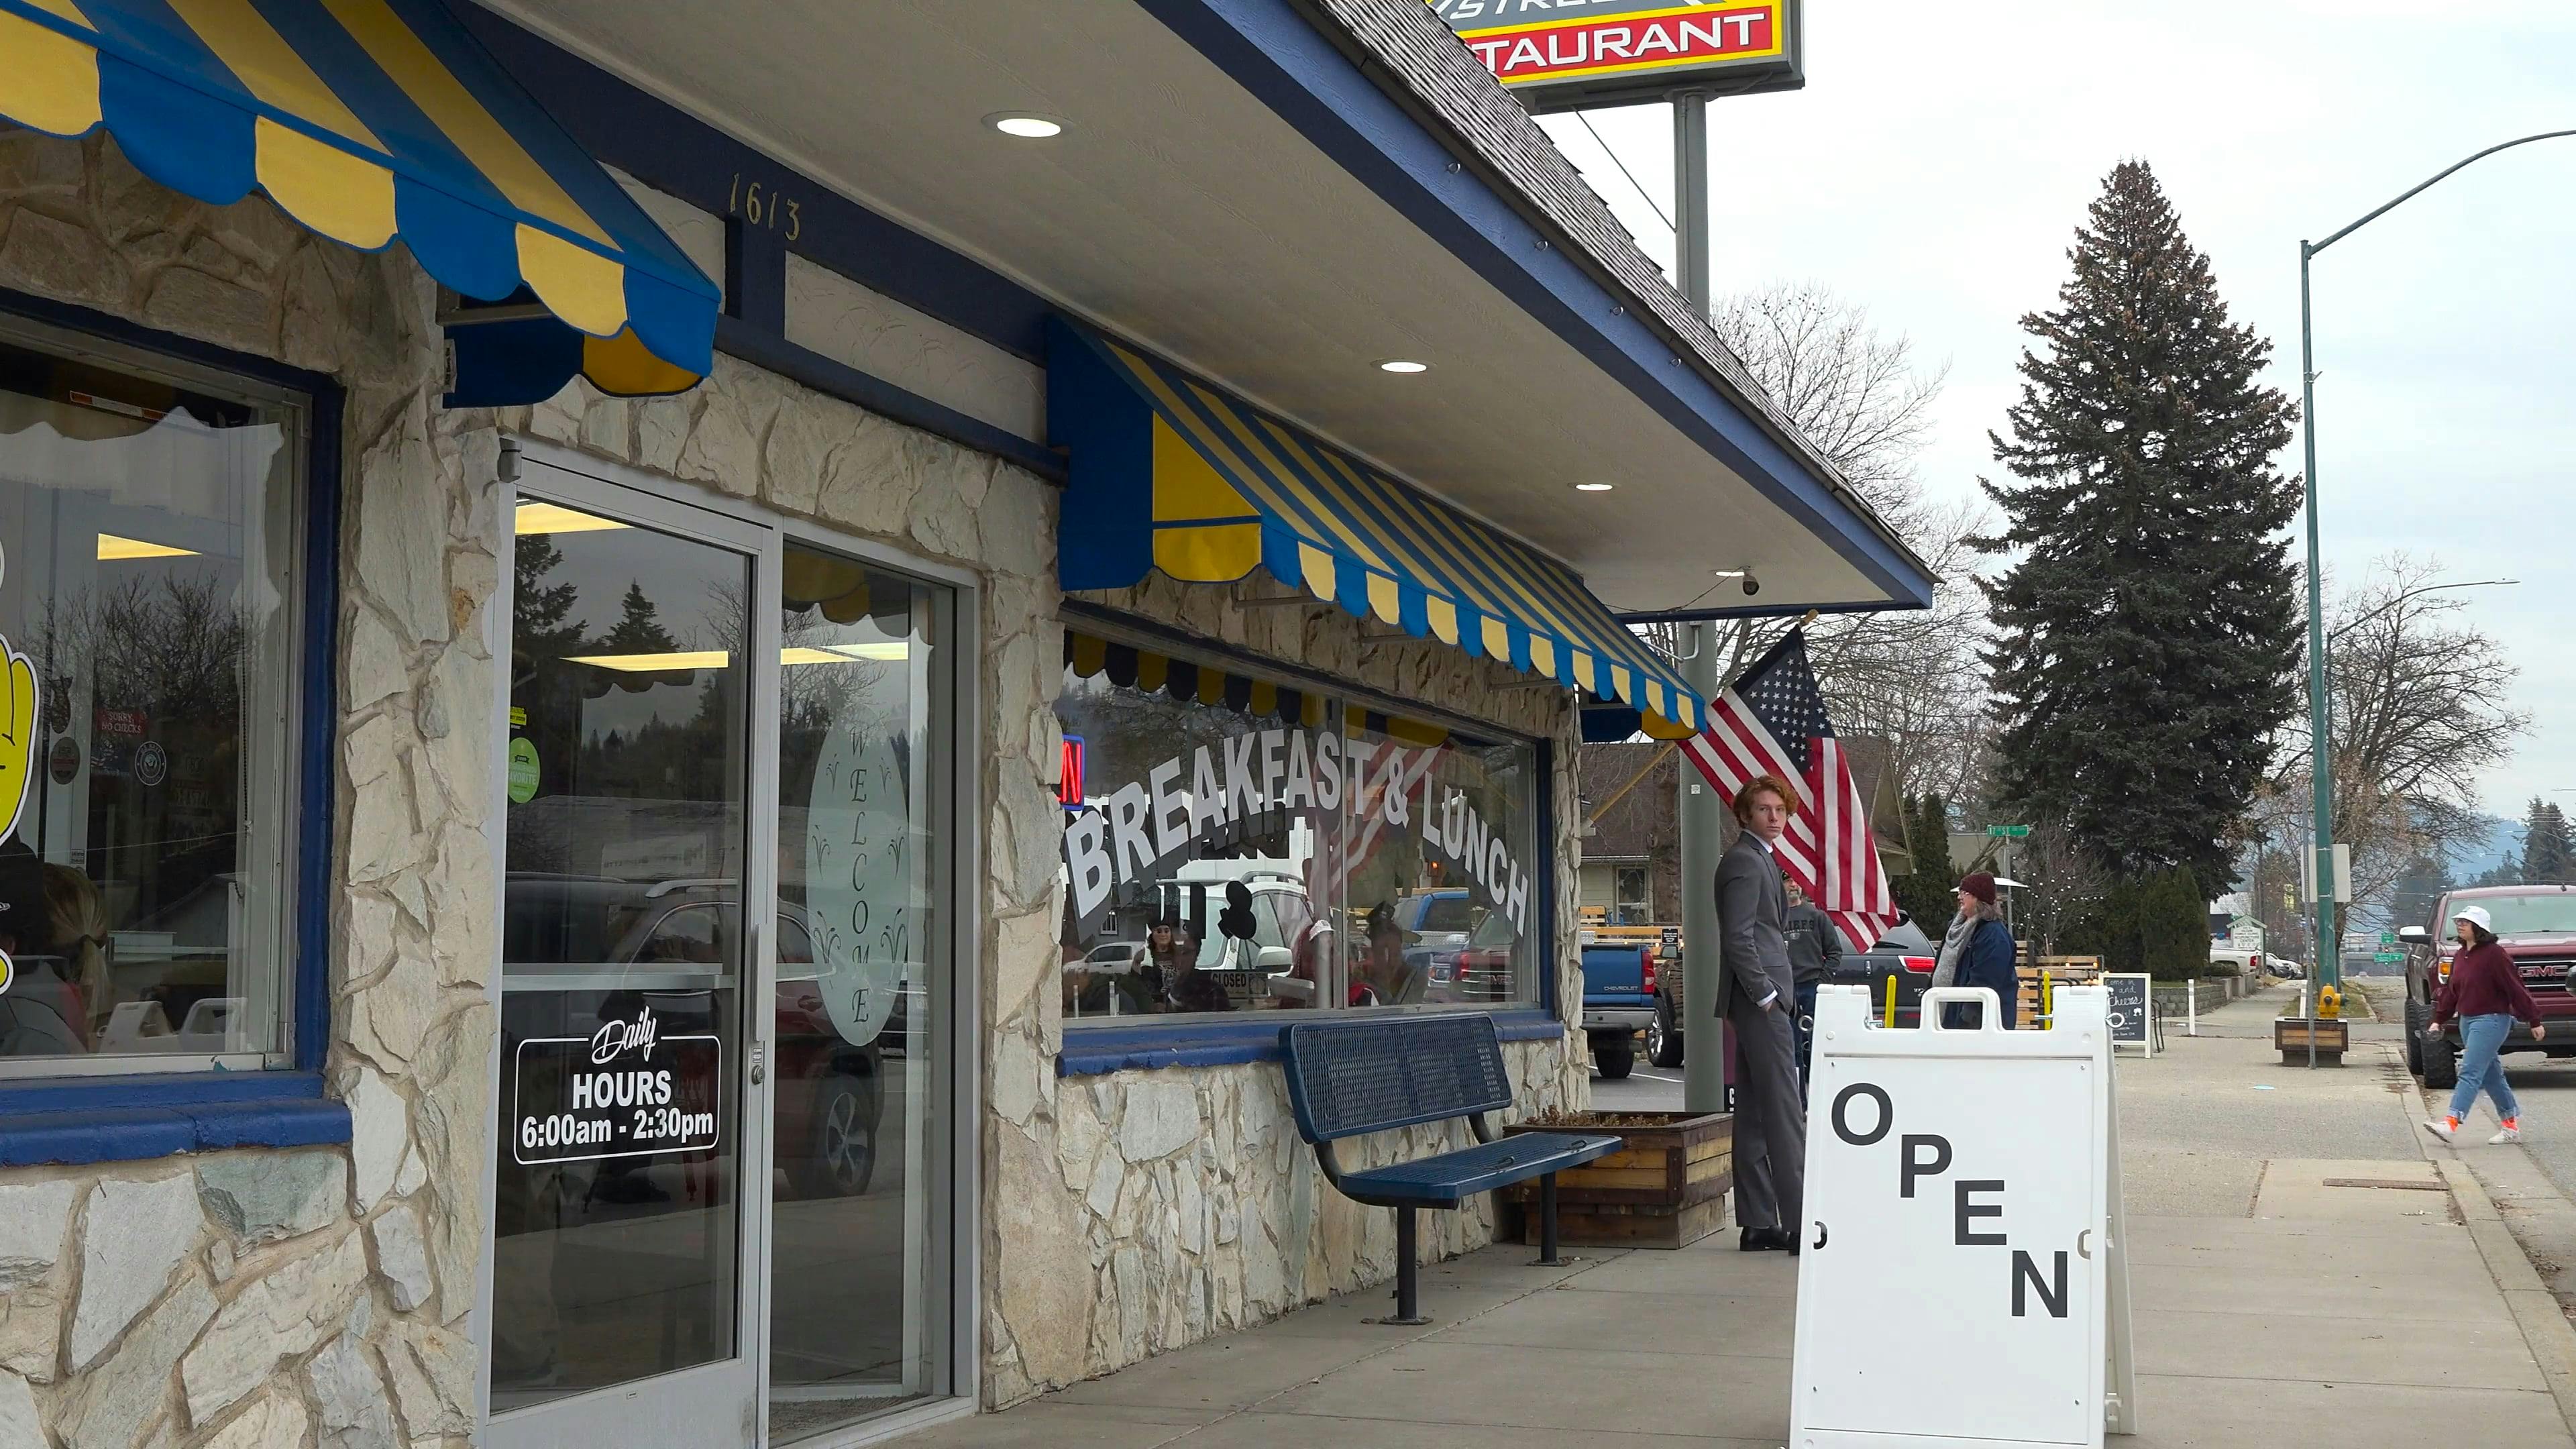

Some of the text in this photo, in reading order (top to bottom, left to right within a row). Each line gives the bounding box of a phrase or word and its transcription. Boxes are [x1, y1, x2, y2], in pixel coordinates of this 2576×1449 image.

[730, 172, 800, 241] 1613
[113, 722, 142, 734] CHECKS
[508, 771, 537, 786] AVORITE
[1066, 729, 1529, 937] BREAKFAST & LUNCH
[2518, 965, 2569, 977] GMC
[591, 1006, 657, 1064] Daily
[572, 1070, 672, 1110] HOURS
[522, 1114, 612, 1148] 6:00am
[633, 1108, 714, 1144] 2:30pm
[1831, 1082, 2068, 1319] OPEN
